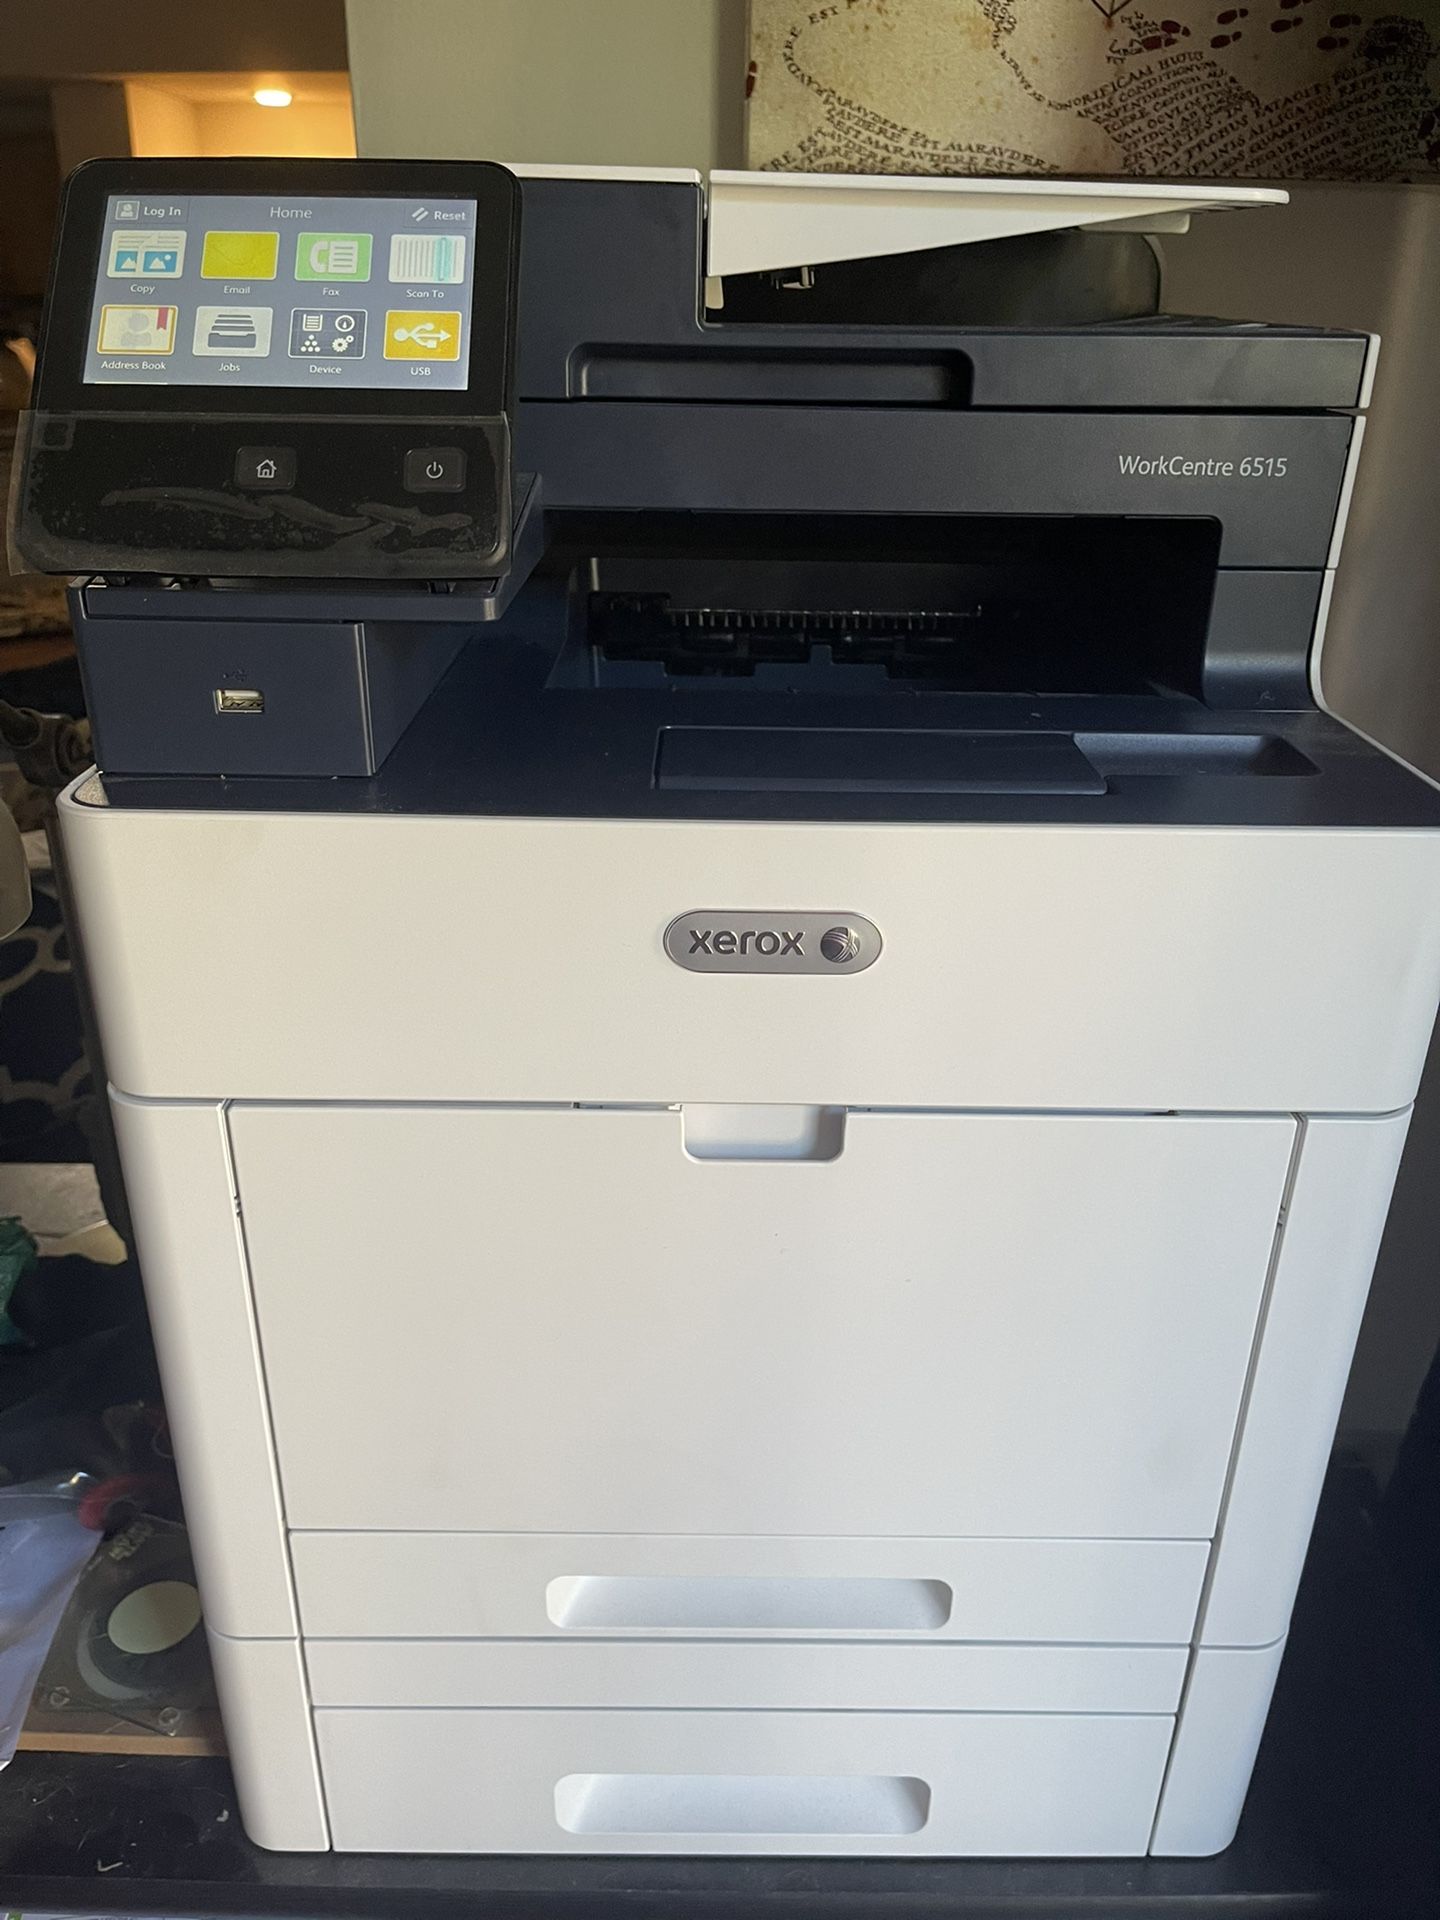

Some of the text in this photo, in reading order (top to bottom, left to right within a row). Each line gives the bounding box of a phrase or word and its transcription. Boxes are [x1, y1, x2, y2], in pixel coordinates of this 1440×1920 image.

[144, 206, 182, 218] Log In
[270, 206, 312, 219] Home
[434, 210, 466, 222] Reset
[130, 284, 155, 296] Copy
[223, 285, 251, 296] Email
[322, 287, 340, 297] Fax
[406, 289, 444, 299] Scan To
[101, 361, 166, 371] Address Book
[218, 362, 240, 373] Jobs
[309, 364, 341, 375] Device
[410, 367, 431, 376] USB
[1118, 454, 1288, 478] WorkCentre 6515
[688, 929, 807, 957] xerox
